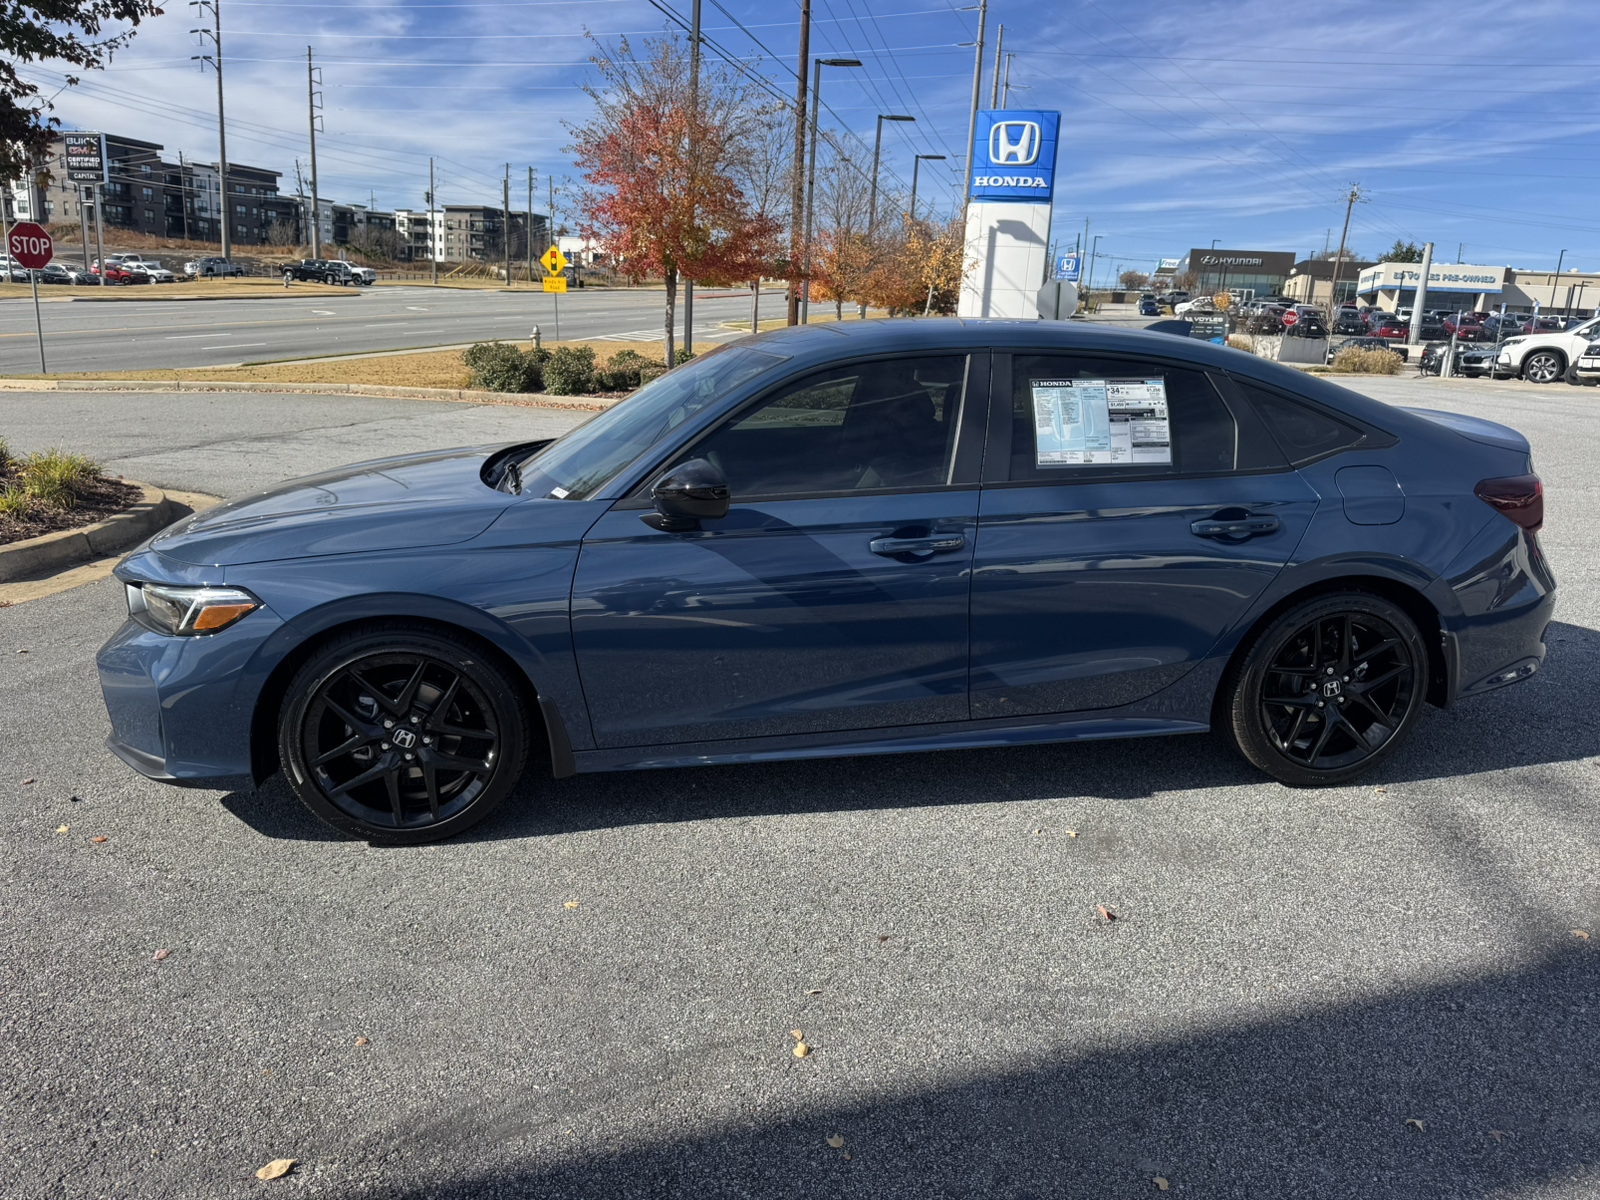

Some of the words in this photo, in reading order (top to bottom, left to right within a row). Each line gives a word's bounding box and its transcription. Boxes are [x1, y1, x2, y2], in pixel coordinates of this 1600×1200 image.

[66, 137, 98, 145] BUICK
[973, 176, 1048, 188] HONDA
[11, 235, 50, 255] STOP
[1219, 257, 1262, 266] HYUNDAI
[1408, 272, 1441, 281] VOES
[1442, 273, 1496, 283] PRE-OWNED
[1283, 314, 1298, 322] STOP
